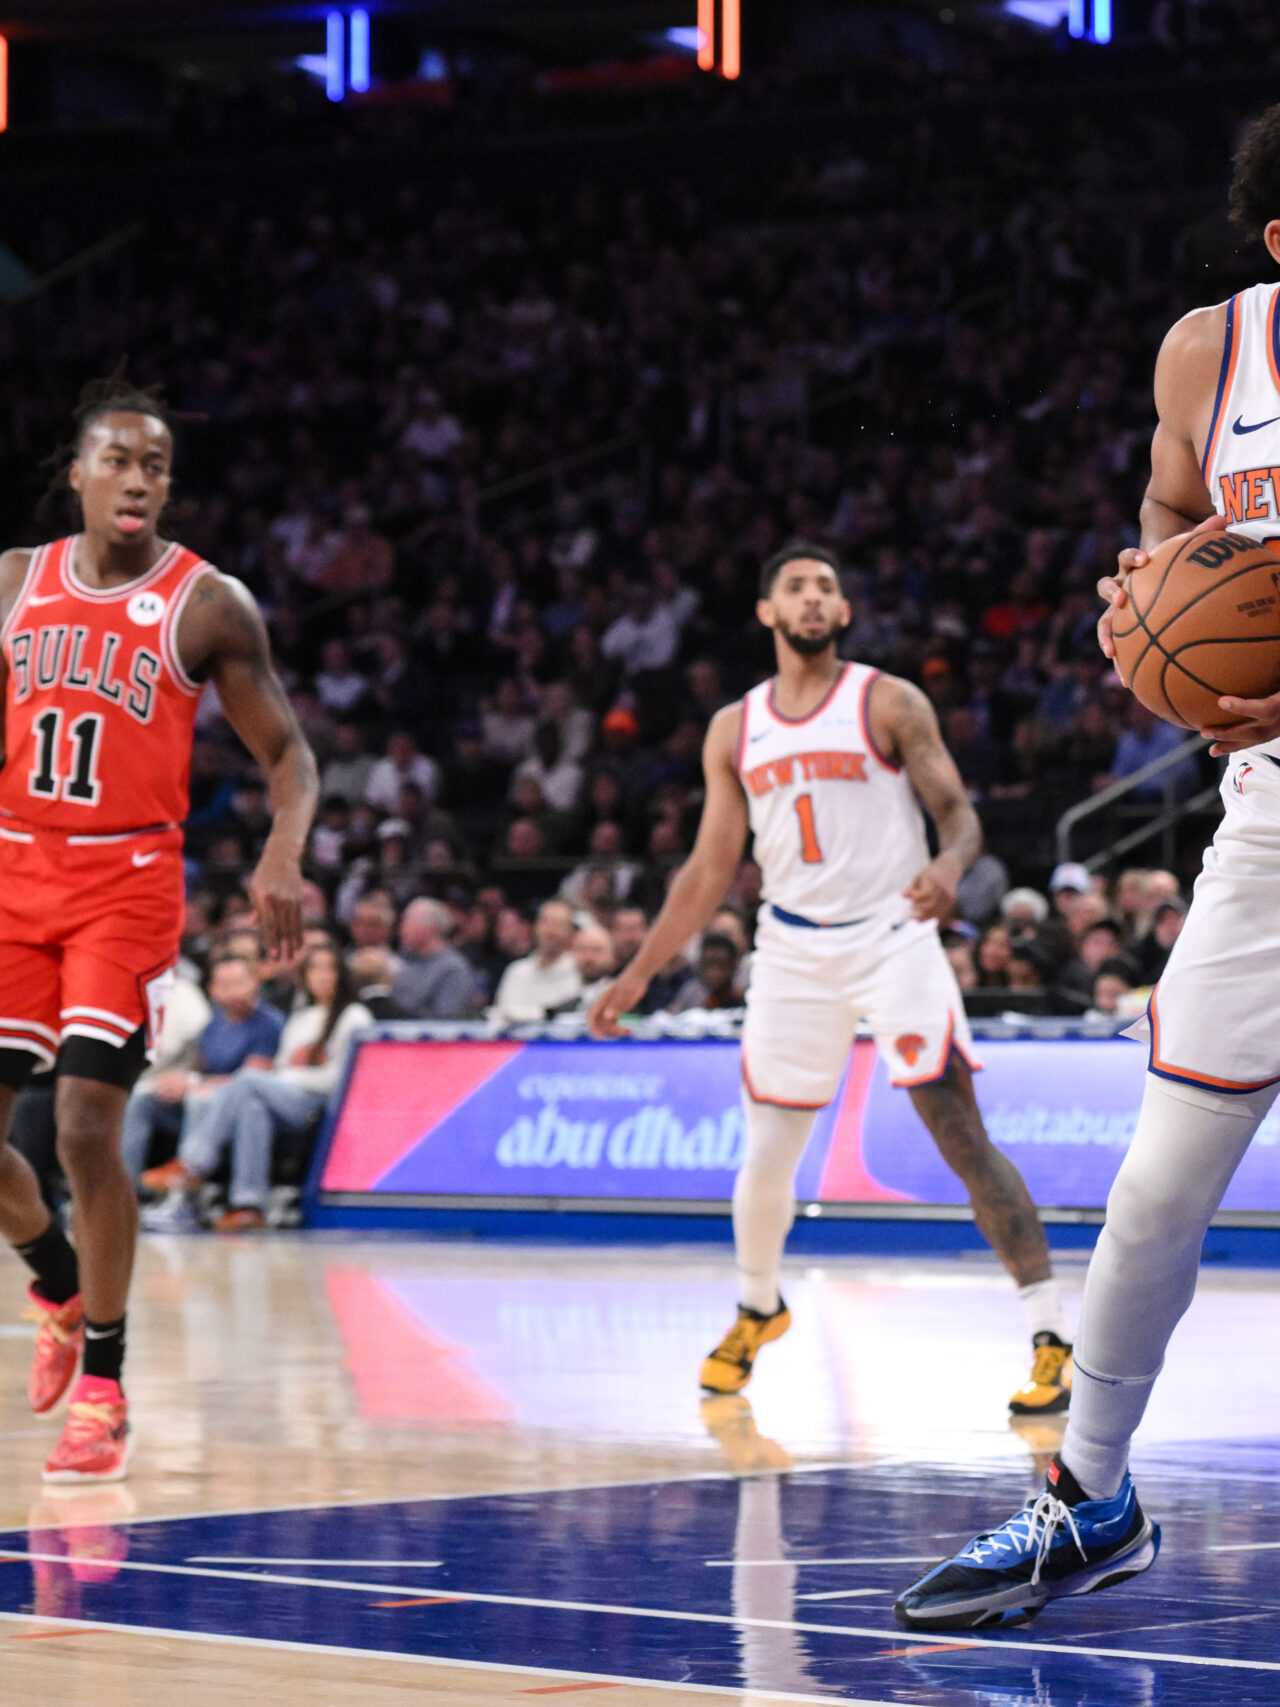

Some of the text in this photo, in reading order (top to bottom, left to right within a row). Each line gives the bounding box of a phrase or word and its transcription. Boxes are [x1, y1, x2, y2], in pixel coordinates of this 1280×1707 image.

[9, 623, 162, 726] BULLS
[27, 706, 104, 808] 11
[796, 750, 869, 783] YORK
[793, 793, 825, 865] 1
[495, 1102, 747, 1170] abu dhab
